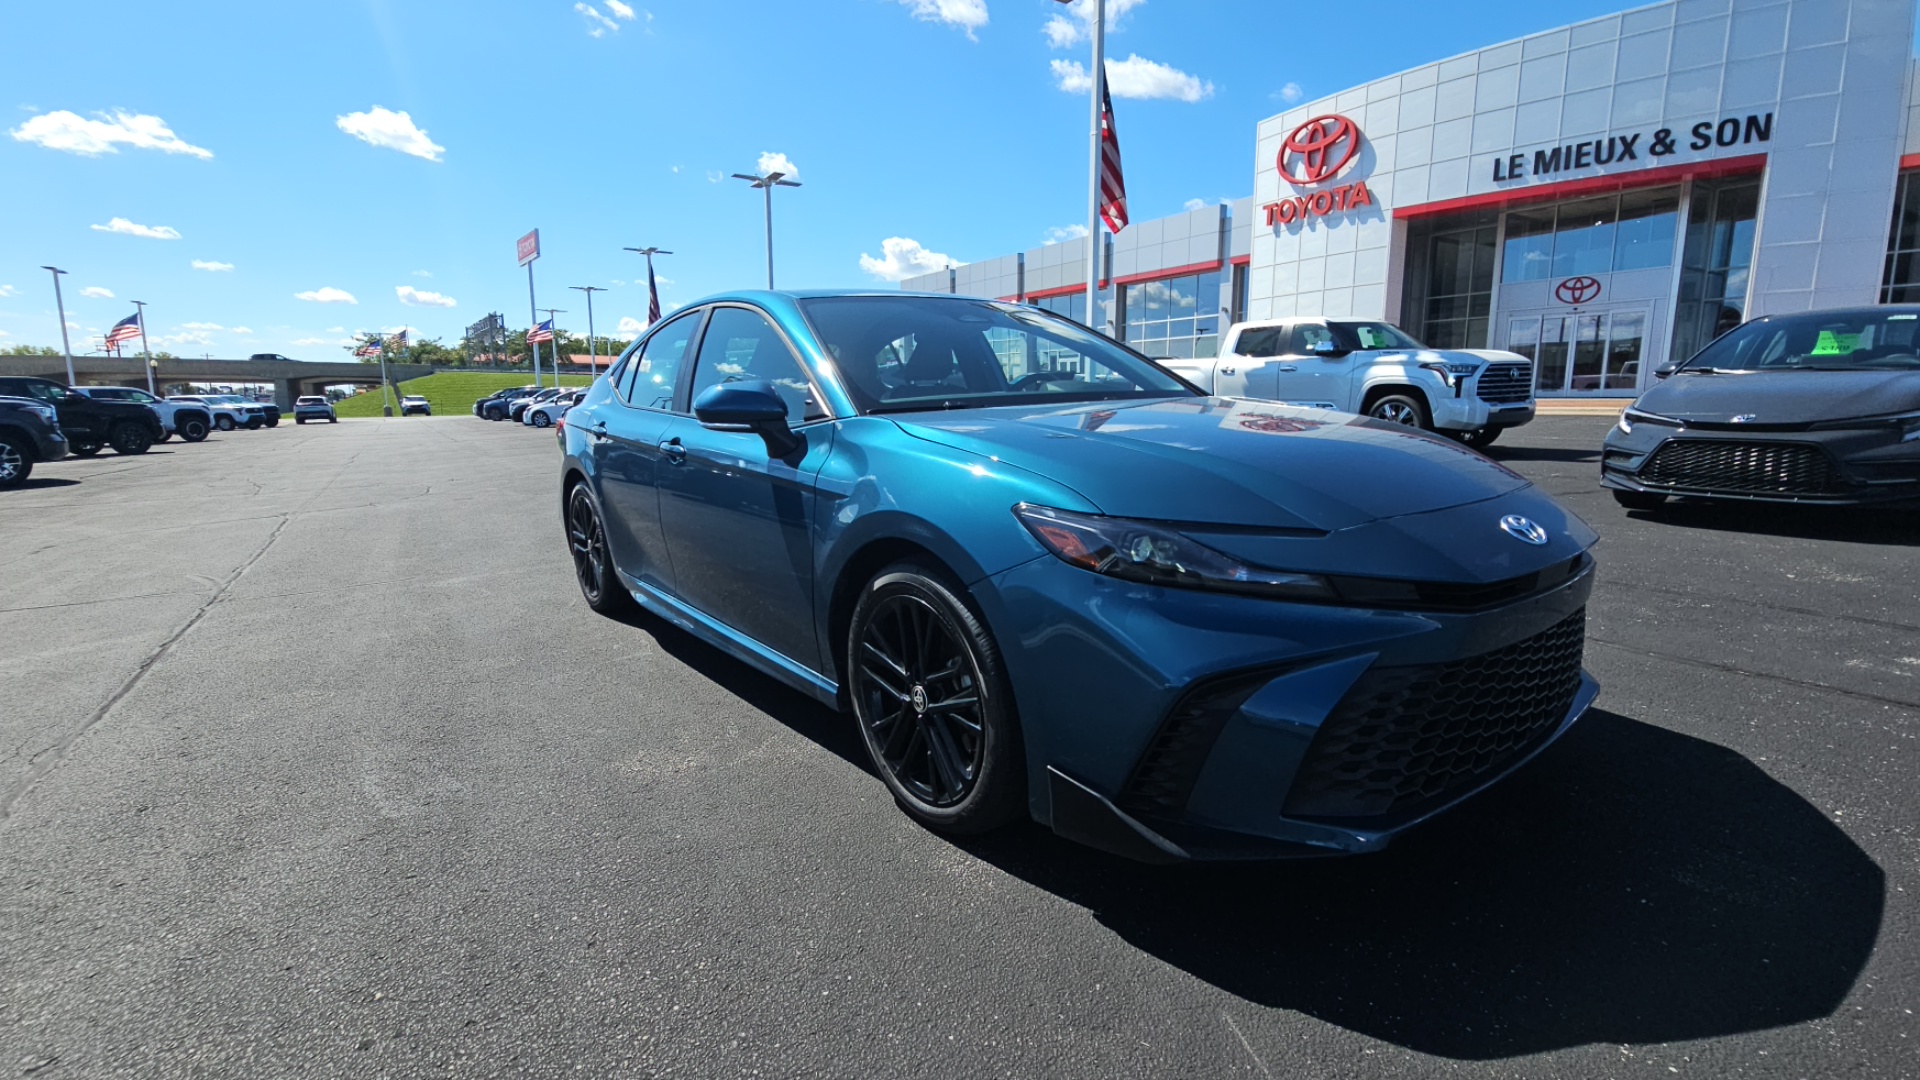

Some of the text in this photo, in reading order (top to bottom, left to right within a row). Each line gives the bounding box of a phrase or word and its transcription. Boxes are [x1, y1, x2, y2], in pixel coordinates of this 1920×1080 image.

[1493, 112, 1773, 182] LE MIEUX & SON
[1263, 181, 1371, 226] TOYOTA
